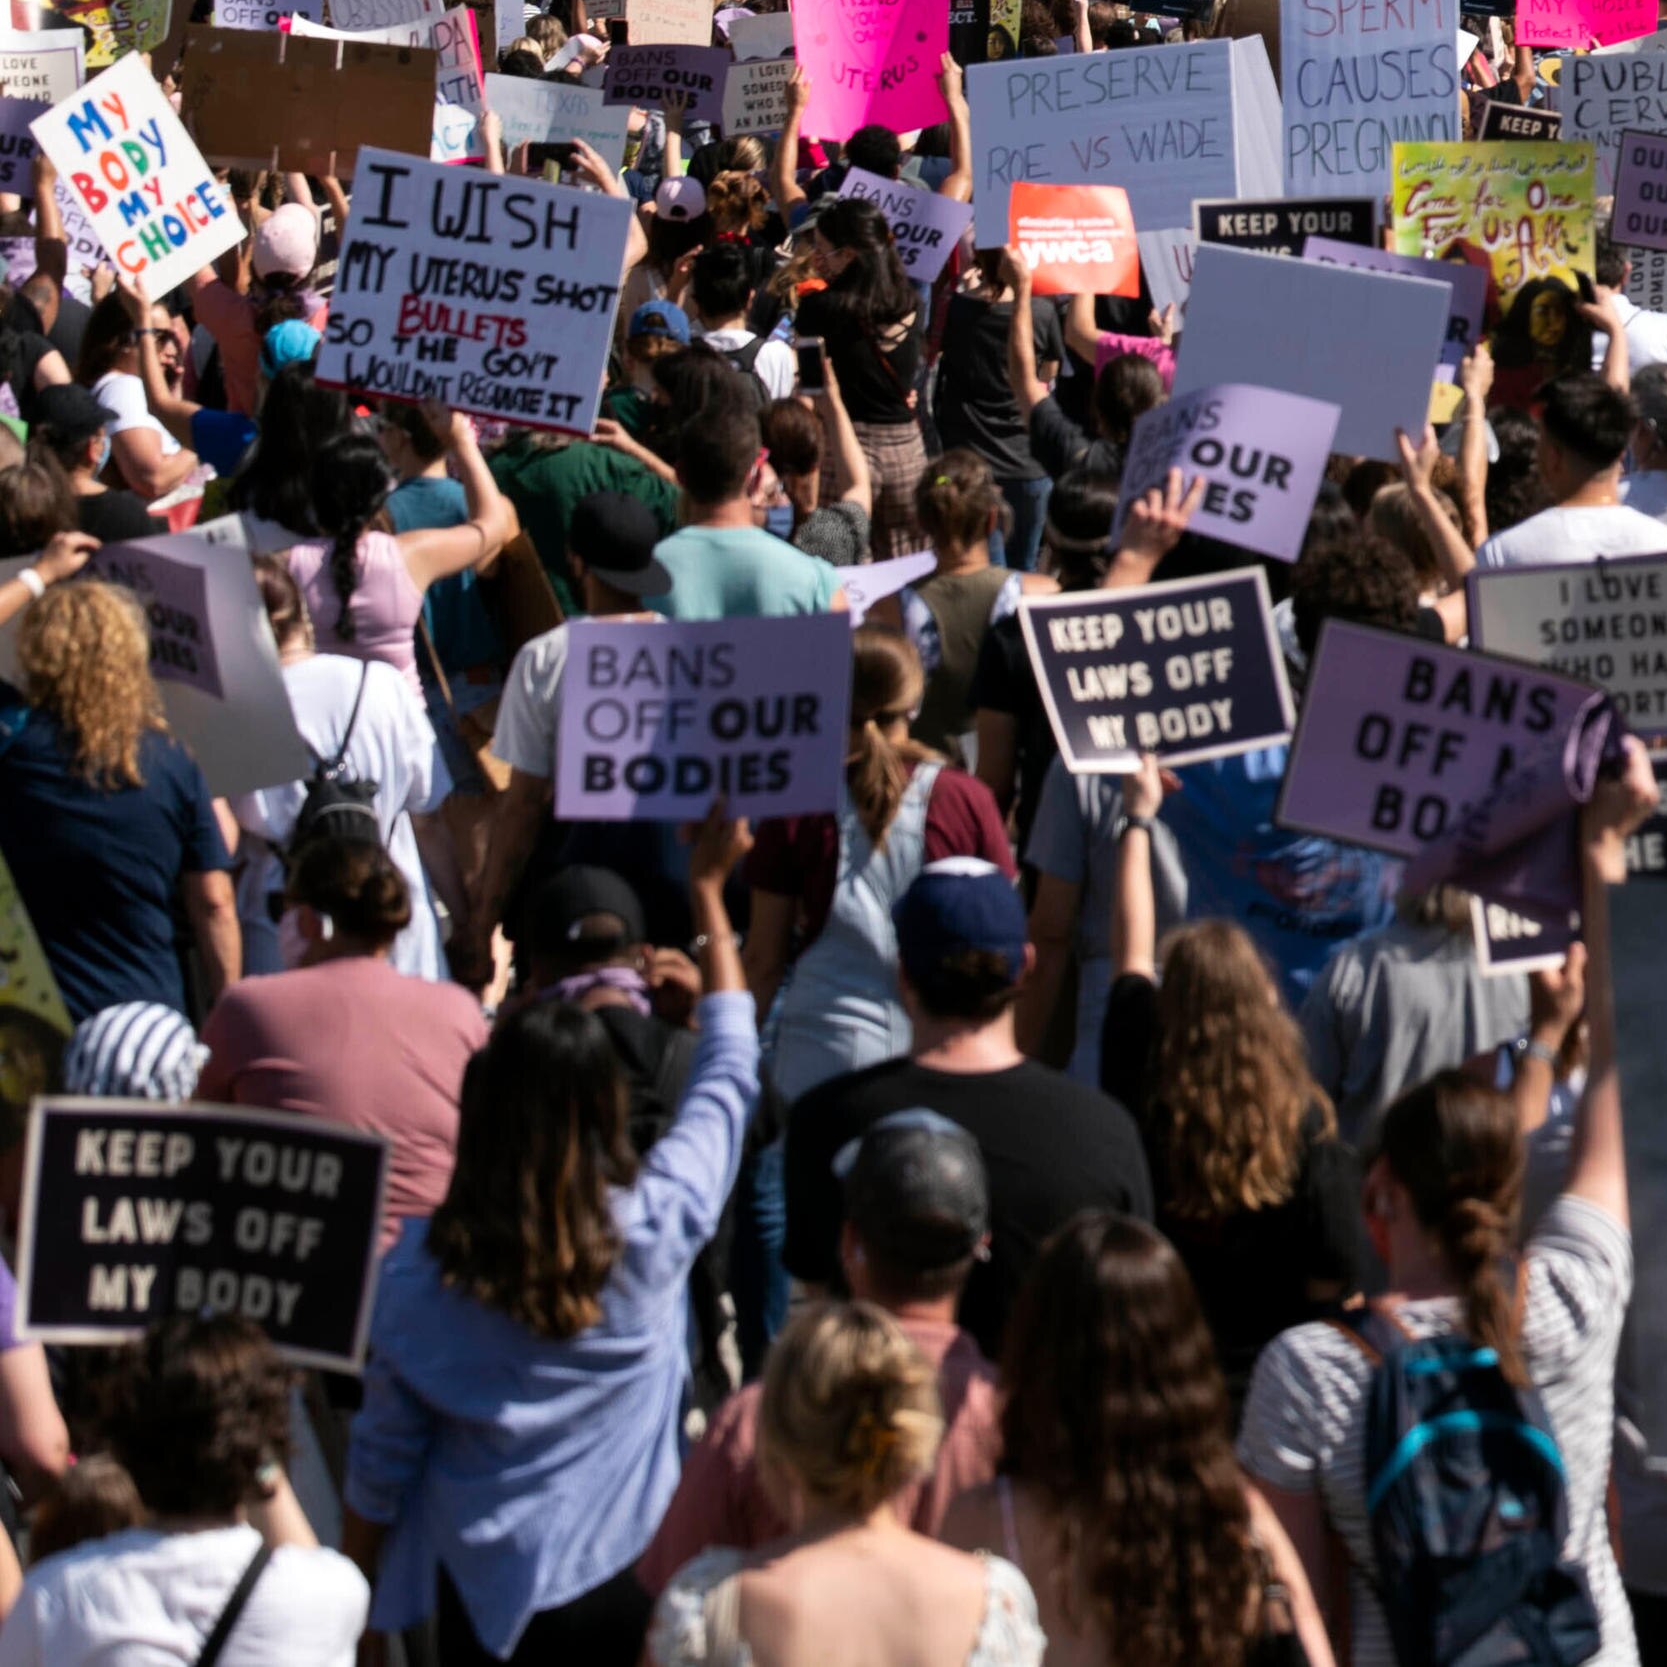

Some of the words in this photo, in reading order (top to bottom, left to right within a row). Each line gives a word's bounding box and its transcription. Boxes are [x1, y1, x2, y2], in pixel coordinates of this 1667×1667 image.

[831, 55, 920, 94] UTERUS
[1006, 50, 1216, 118] PRESERVE
[1297, 43, 1456, 109] CAUSES
[66, 92, 129, 154] MY
[70, 117, 167, 215] BODY
[986, 144, 1052, 192] ROE
[1070, 136, 1111, 174] VS
[1121, 117, 1224, 163] WADE
[116, 180, 226, 274] CHOICE
[117, 176, 163, 227] MY
[361, 163, 411, 229] I
[431, 177, 581, 251] WISH
[1217, 213, 1278, 237] KEEP
[1288, 211, 1353, 234] YOUR
[339, 240, 397, 293] MY
[409, 252, 528, 303] UTERUS
[530, 274, 619, 315] SHOT
[1018, 238, 1114, 270] ywca
[327, 312, 374, 347] SO
[390, 336, 459, 363] THE
[396, 293, 528, 348] BULLETS
[1560, 578, 1570, 607] I
[1586, 574, 1662, 604] LOVE
[1047, 614, 1122, 654] KEEP
[1133, 596, 1235, 643] YOUR
[586, 643, 736, 691] BANS
[1066, 662, 1153, 703] LAWS
[1164, 651, 1235, 692] OFF
[583, 697, 698, 743] OFF
[708, 692, 820, 740] OUR
[1086, 711, 1130, 753] MY
[1134, 700, 1235, 750] BODY
[580, 748, 793, 796] BODIES
[73, 1129, 192, 1179] KEEP
[216, 1138, 343, 1200] YOUR
[81, 1194, 216, 1249] LAWS
[232, 1208, 325, 1264] OFF
[87, 1266, 157, 1314] MY
[174, 1271, 304, 1327] BODY
